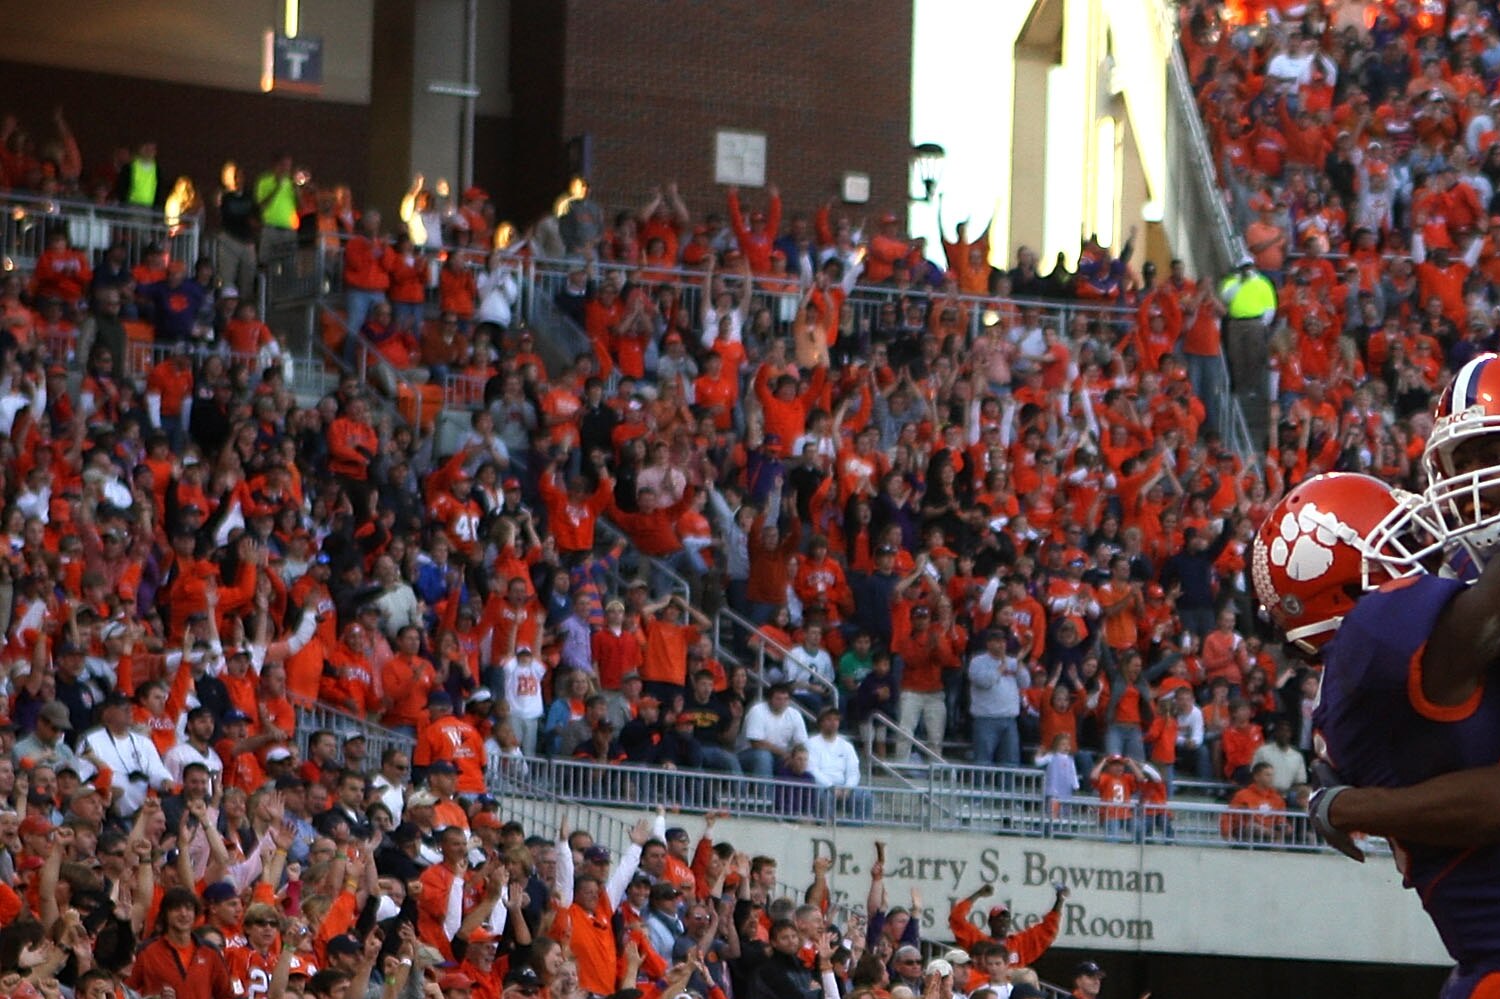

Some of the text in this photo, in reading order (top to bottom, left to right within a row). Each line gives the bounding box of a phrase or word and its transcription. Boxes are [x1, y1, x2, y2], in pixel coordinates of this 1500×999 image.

[811, 838, 860, 875] Dr.
[980, 848, 1010, 884] S.
[1024, 851, 1166, 893] Bowman
[948, 897, 1044, 933] oke
[1065, 903, 1154, 940] Room
